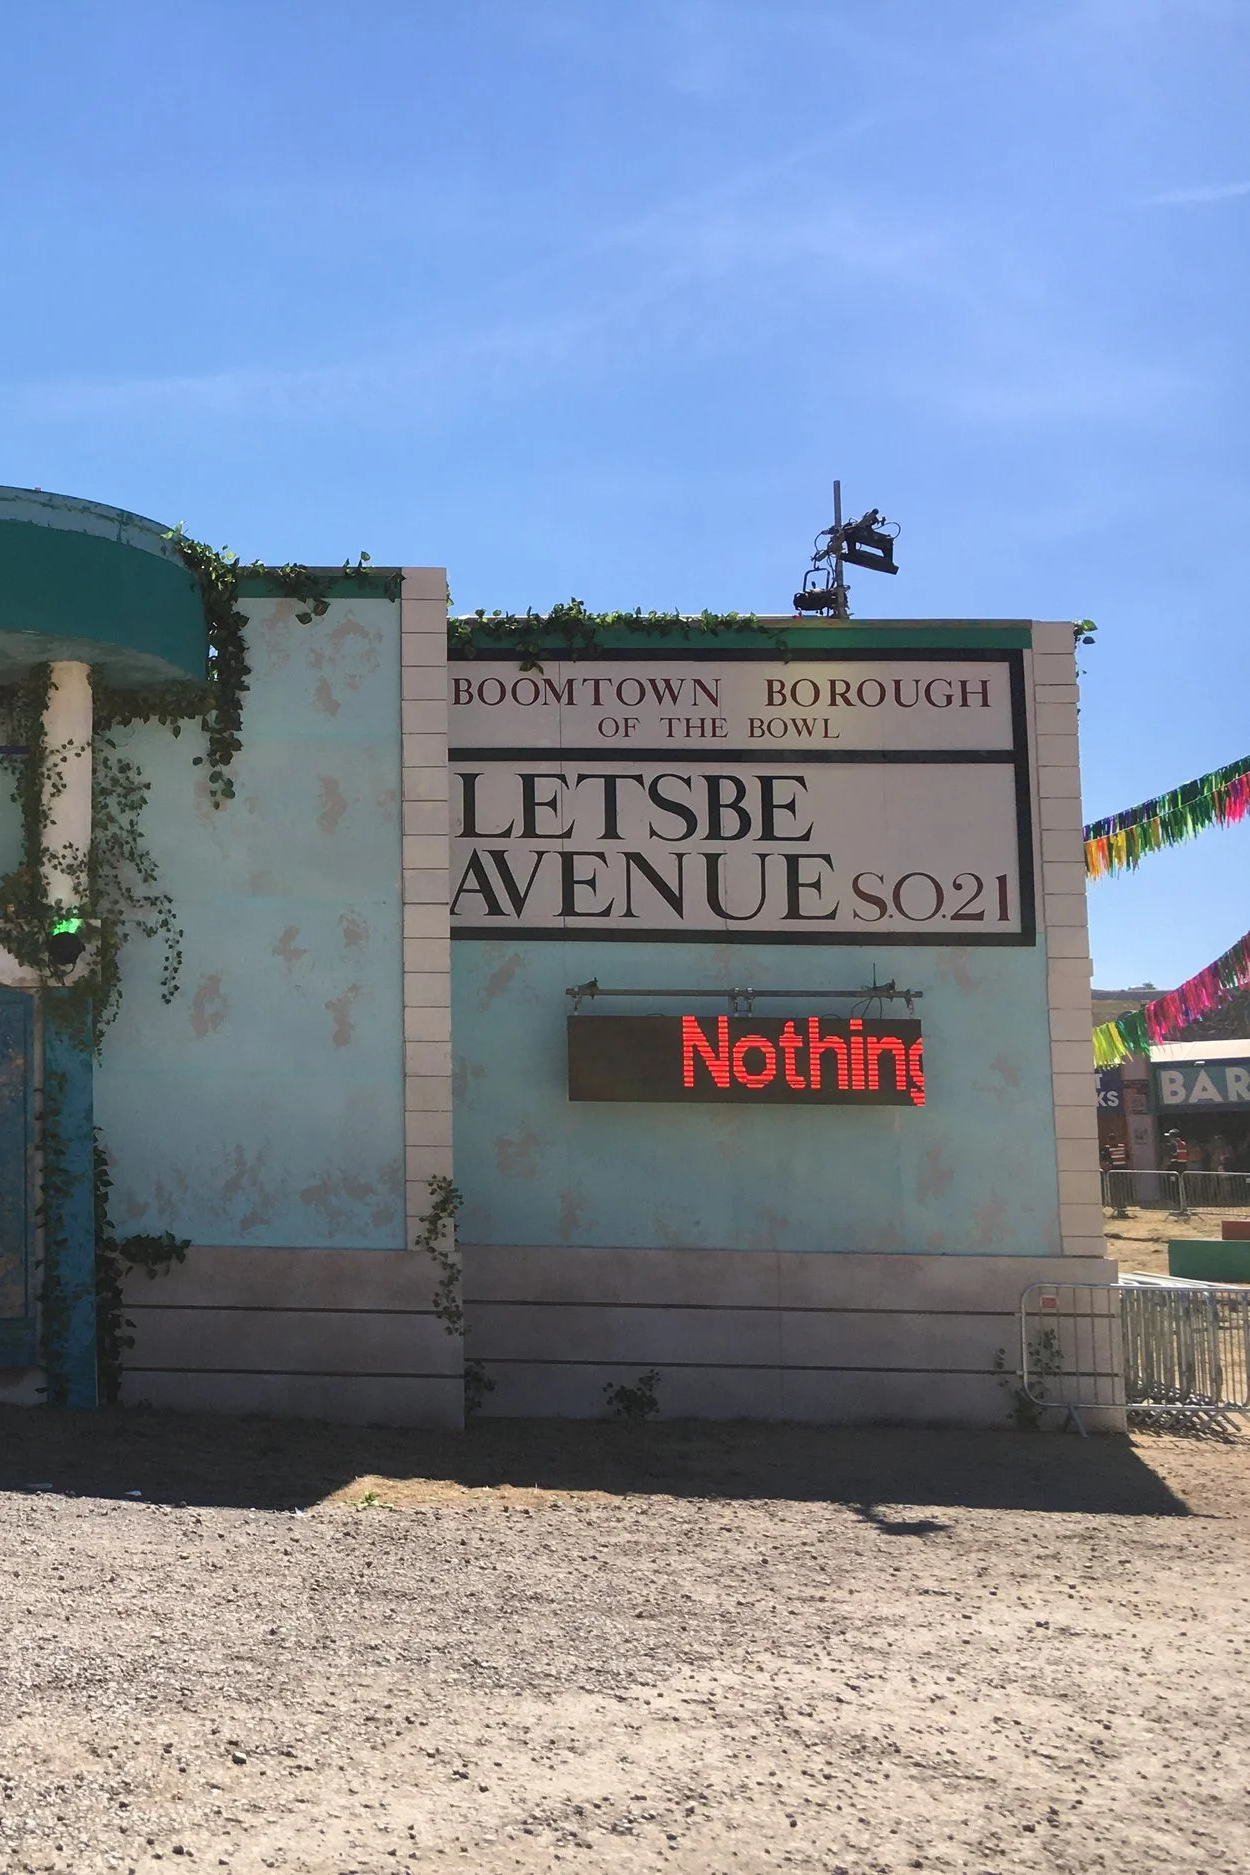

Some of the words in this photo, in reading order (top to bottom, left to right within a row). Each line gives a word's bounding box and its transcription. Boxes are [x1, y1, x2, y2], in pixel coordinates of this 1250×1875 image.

[451, 677, 720, 707] BOOMTOWN
[764, 679, 991, 708] BOROUGH
[597, 716, 640, 738] OF
[659, 717, 728, 739] THE
[748, 718, 841, 739] BOWL
[453, 772, 814, 842] LETSBE
[449, 847, 840, 920] AVENUE
